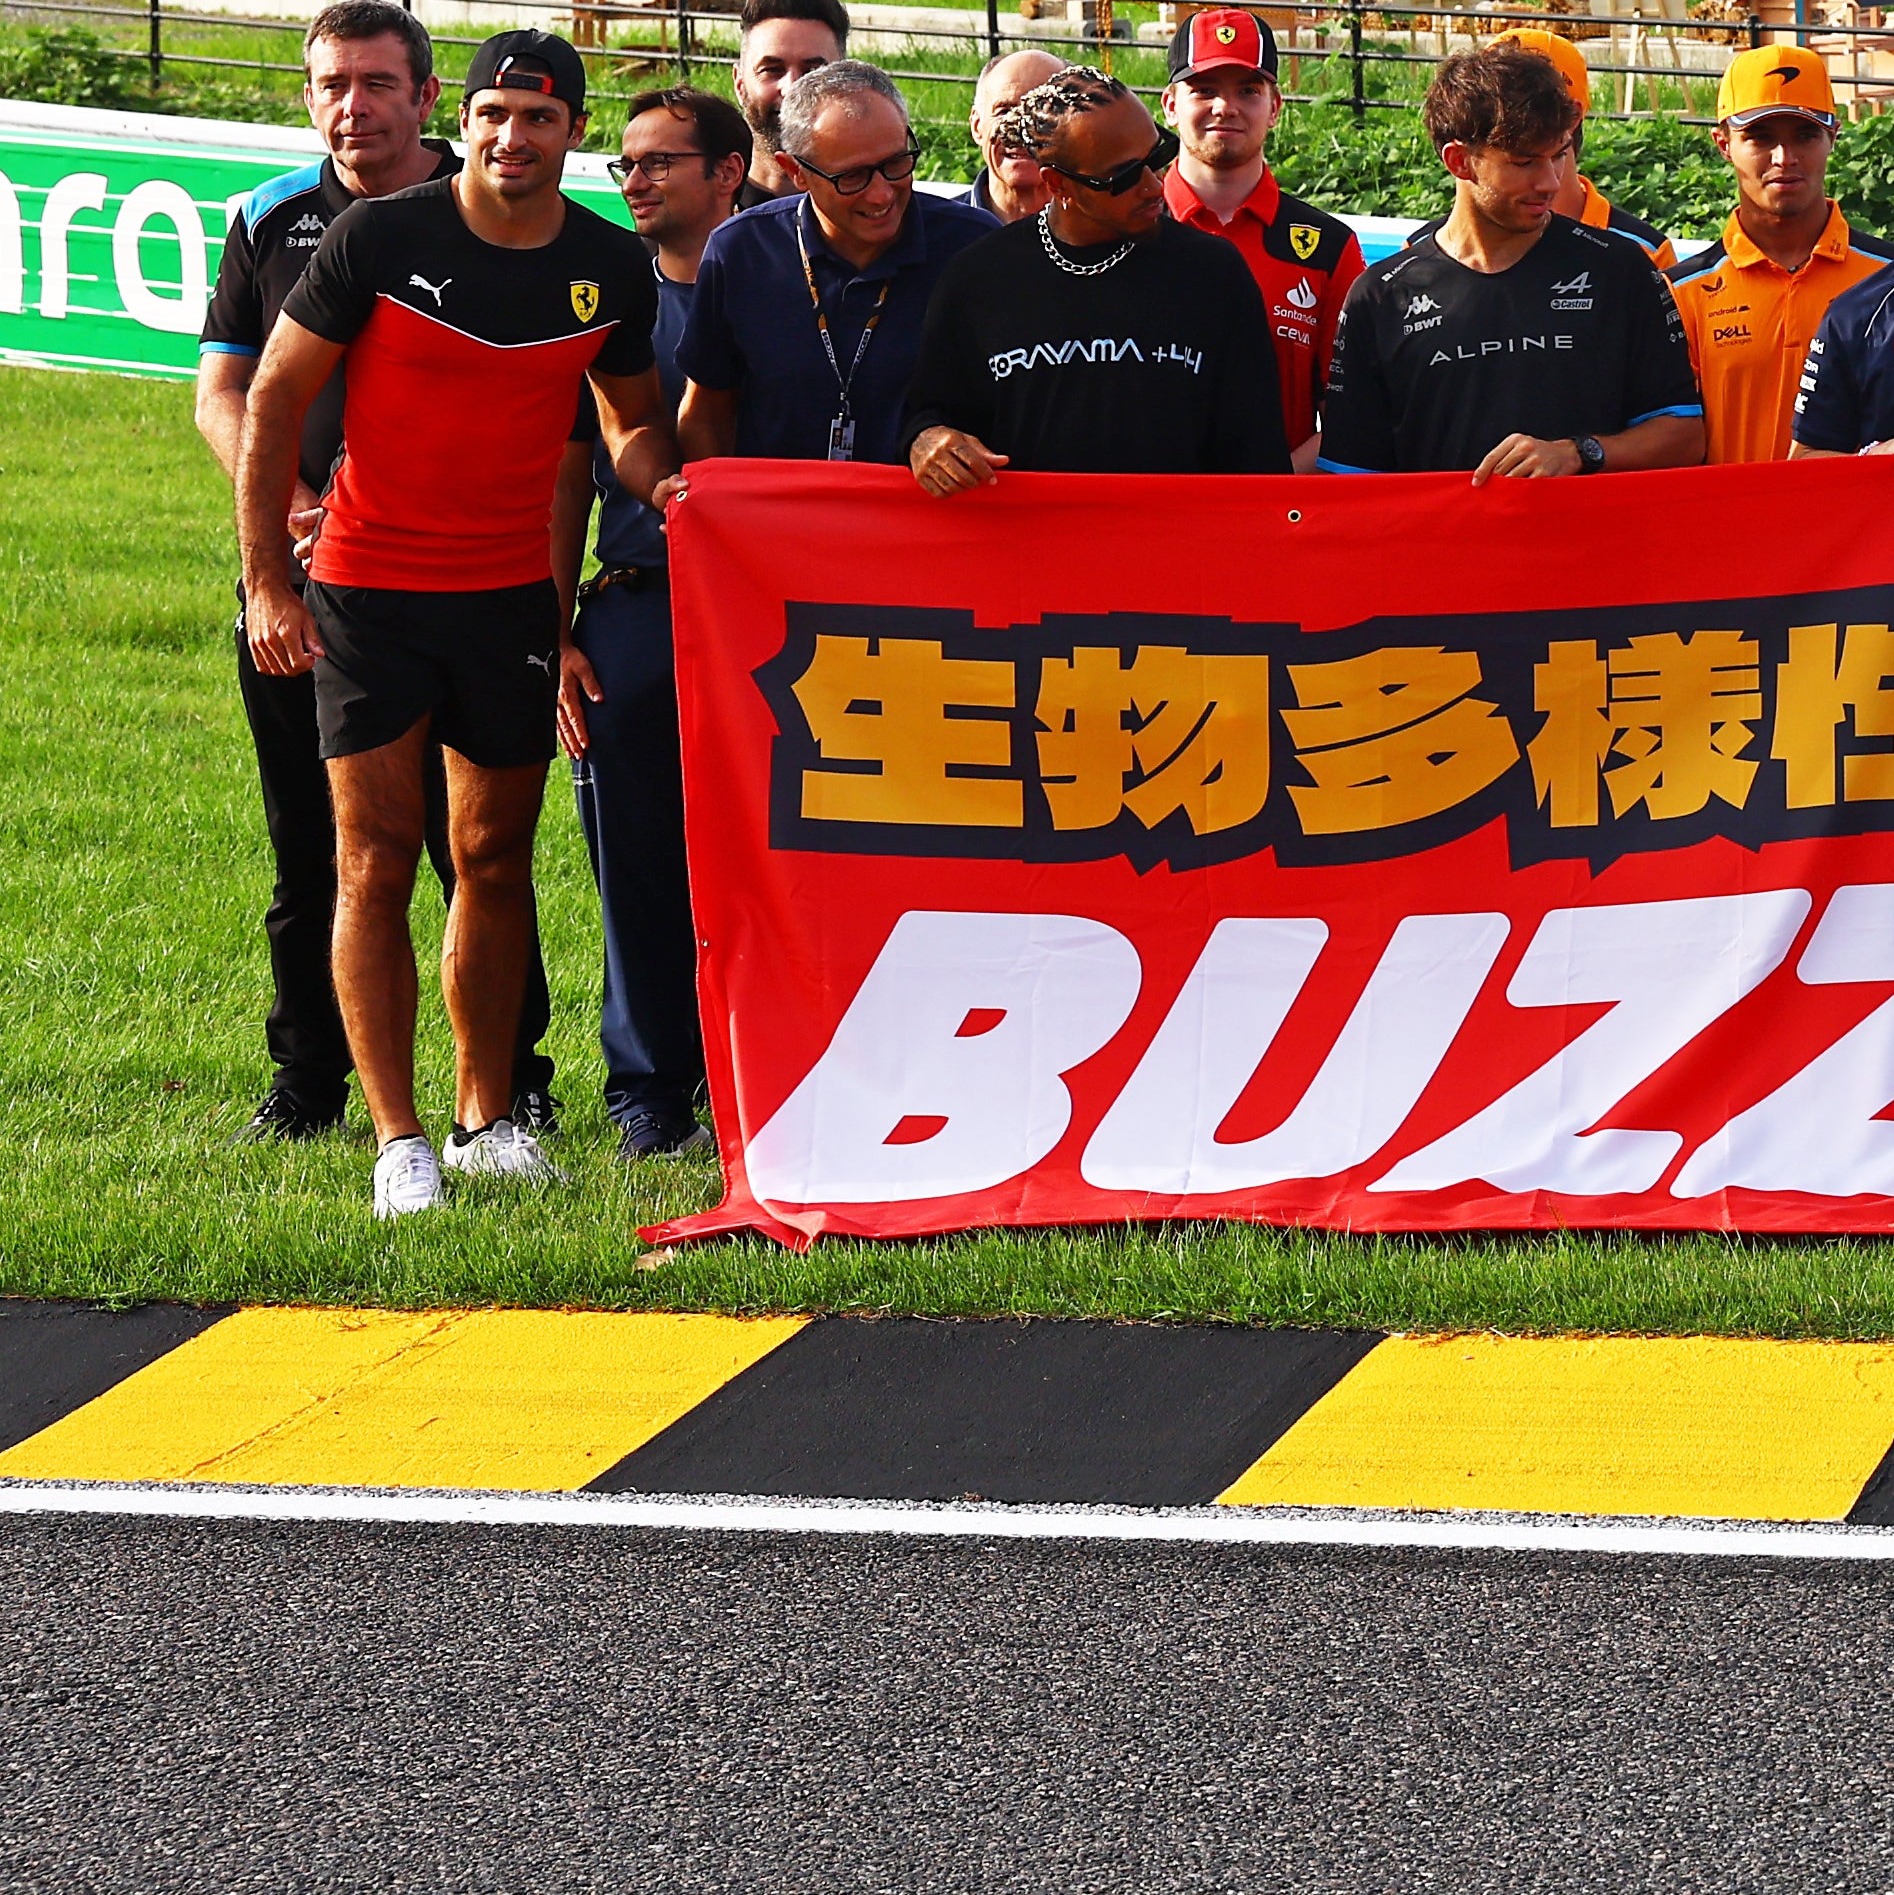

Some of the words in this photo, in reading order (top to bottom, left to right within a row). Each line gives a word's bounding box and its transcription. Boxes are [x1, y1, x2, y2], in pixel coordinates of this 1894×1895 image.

[1561, 299, 1591, 310] Castrol
[1708, 306, 1739, 319] android
[1413, 314, 1443, 333] BWT
[1713, 324, 1753, 343] DELL
[1428, 335, 1574, 367] ALPINE
